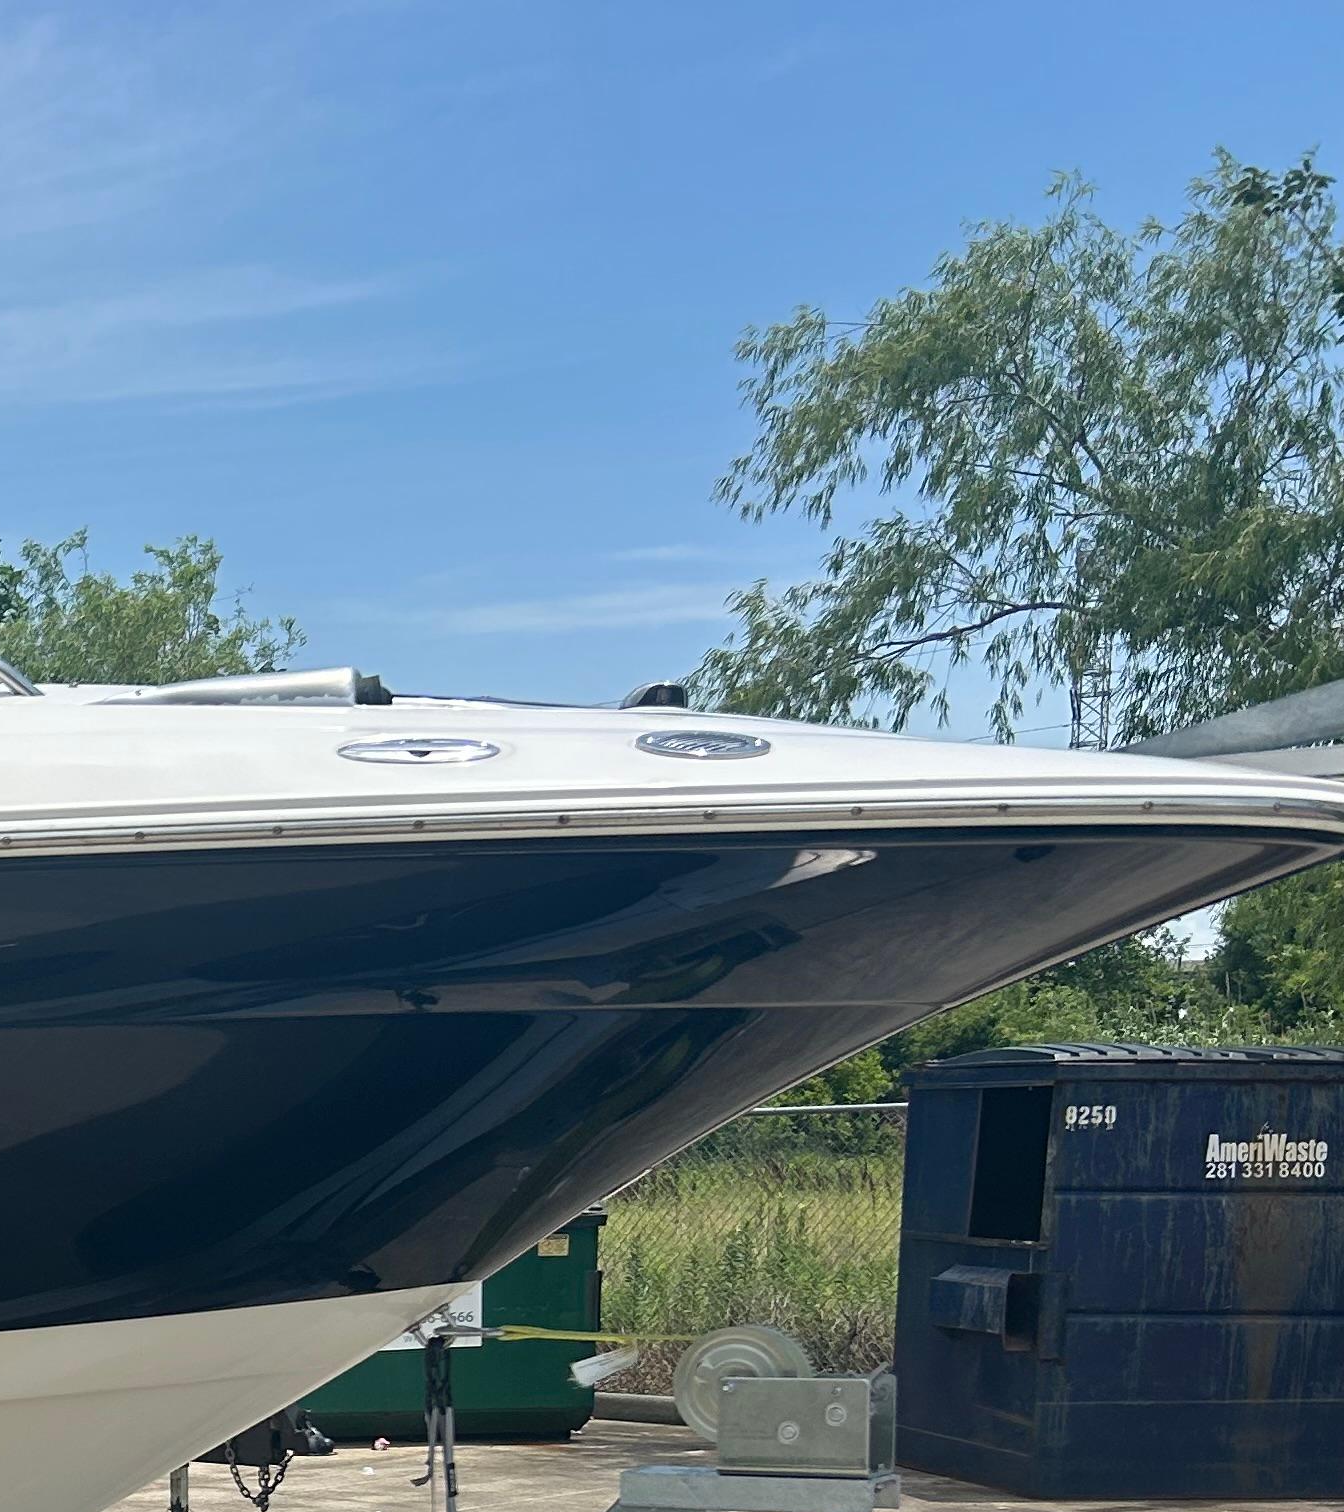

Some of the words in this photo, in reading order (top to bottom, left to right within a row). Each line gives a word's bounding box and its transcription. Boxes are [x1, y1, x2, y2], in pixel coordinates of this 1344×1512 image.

[1205, 1132, 1328, 1163] AmeriWaste
[1205, 1163, 1236, 1180] 281
[1242, 1162, 1274, 1179] 331
[1278, 1161, 1326, 1178] 8400
